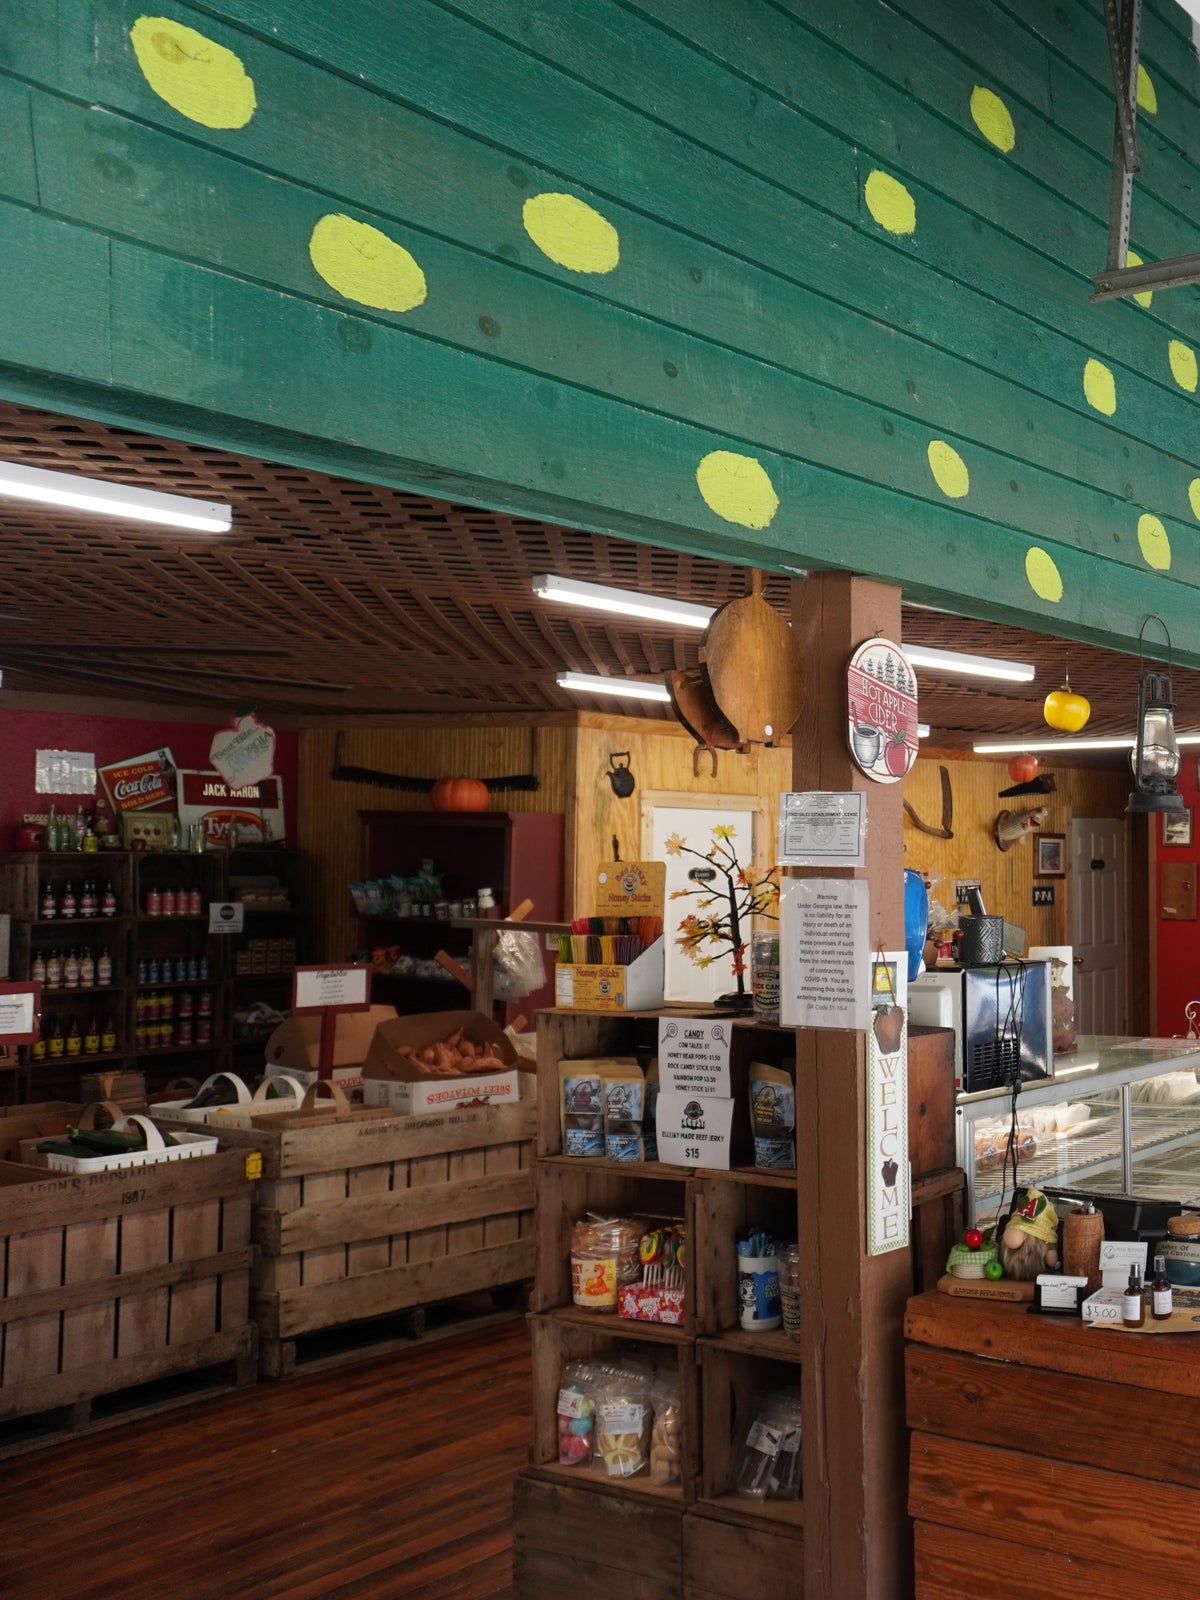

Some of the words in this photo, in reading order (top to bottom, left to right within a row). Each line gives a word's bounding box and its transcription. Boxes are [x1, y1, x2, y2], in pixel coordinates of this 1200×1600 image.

[863, 678, 882, 702] HOT
[883, 692, 908, 717] APPLE
[869, 703, 898, 733] CIDER
[113, 770, 130, 779] ICE
[131, 765, 155, 775] COLD
[114, 772, 163, 801] Coca-Cola
[202, 783, 226, 797] JACK
[120, 797, 146, 810] SOLD
[608, 893, 630, 904] Honey
[631, 892, 652, 902] Sticks
[576, 968, 597, 979] Honey
[598, 968, 620, 978] Sticks
[684, 1030, 704, 1038] CANDY
[427, 1089, 480, 1105] POTATOES
[681, 1132, 695, 1140] MADE
[685, 1148, 699, 1159] $15
